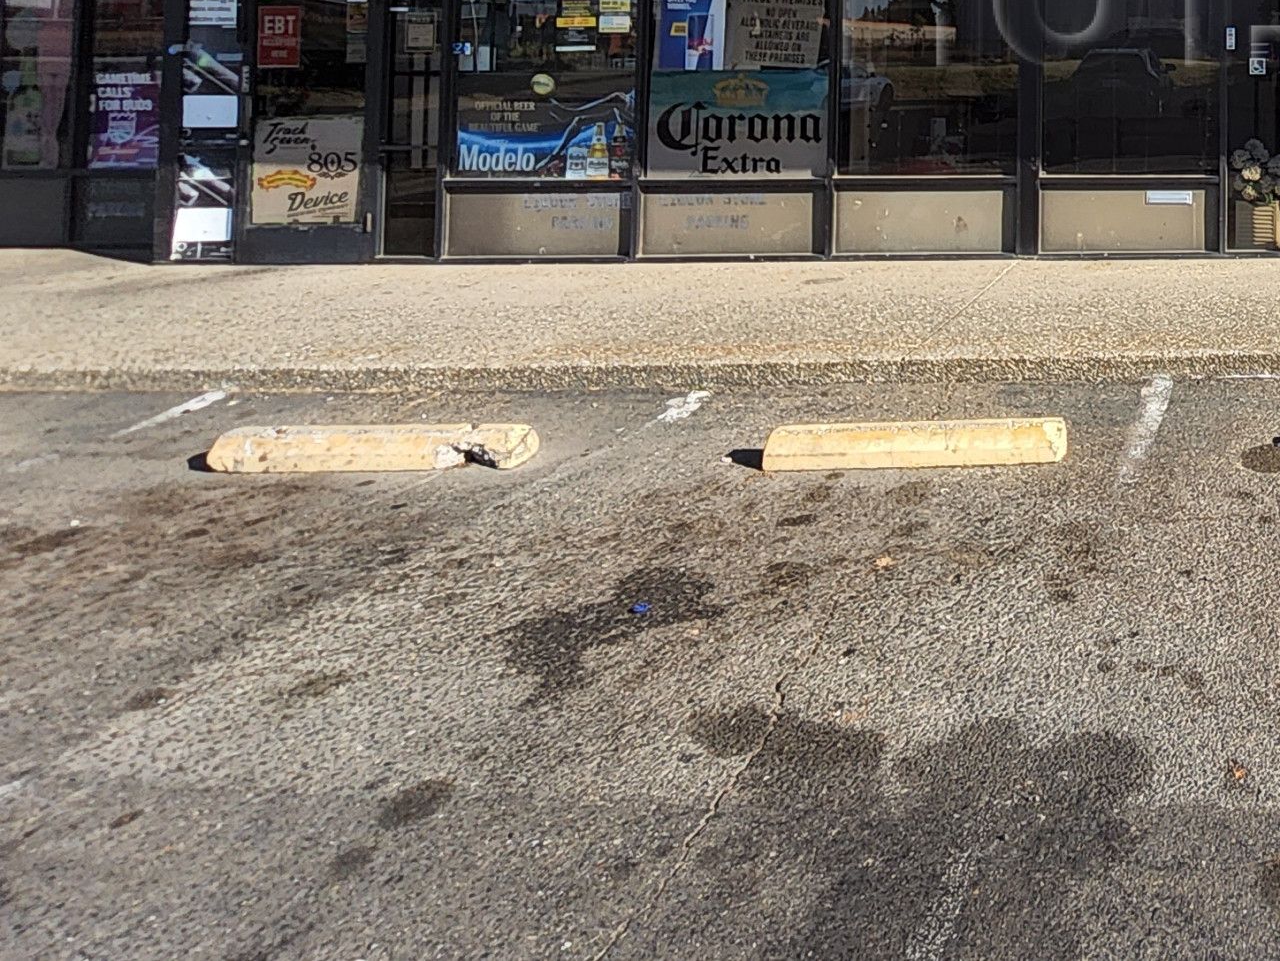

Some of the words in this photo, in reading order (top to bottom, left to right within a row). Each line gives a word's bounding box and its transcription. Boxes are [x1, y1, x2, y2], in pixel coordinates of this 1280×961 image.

[263, 15, 297, 35] EBT
[474, 101, 512, 111] OFFICIAL
[513, 101, 536, 111] BEER
[263, 122, 309, 144] Track
[656, 100, 824, 156] Corona
[307, 152, 358, 173] 805
[458, 144, 536, 172] Modelo
[700, 145, 782, 174] Extra
[287, 191, 349, 212] Device
